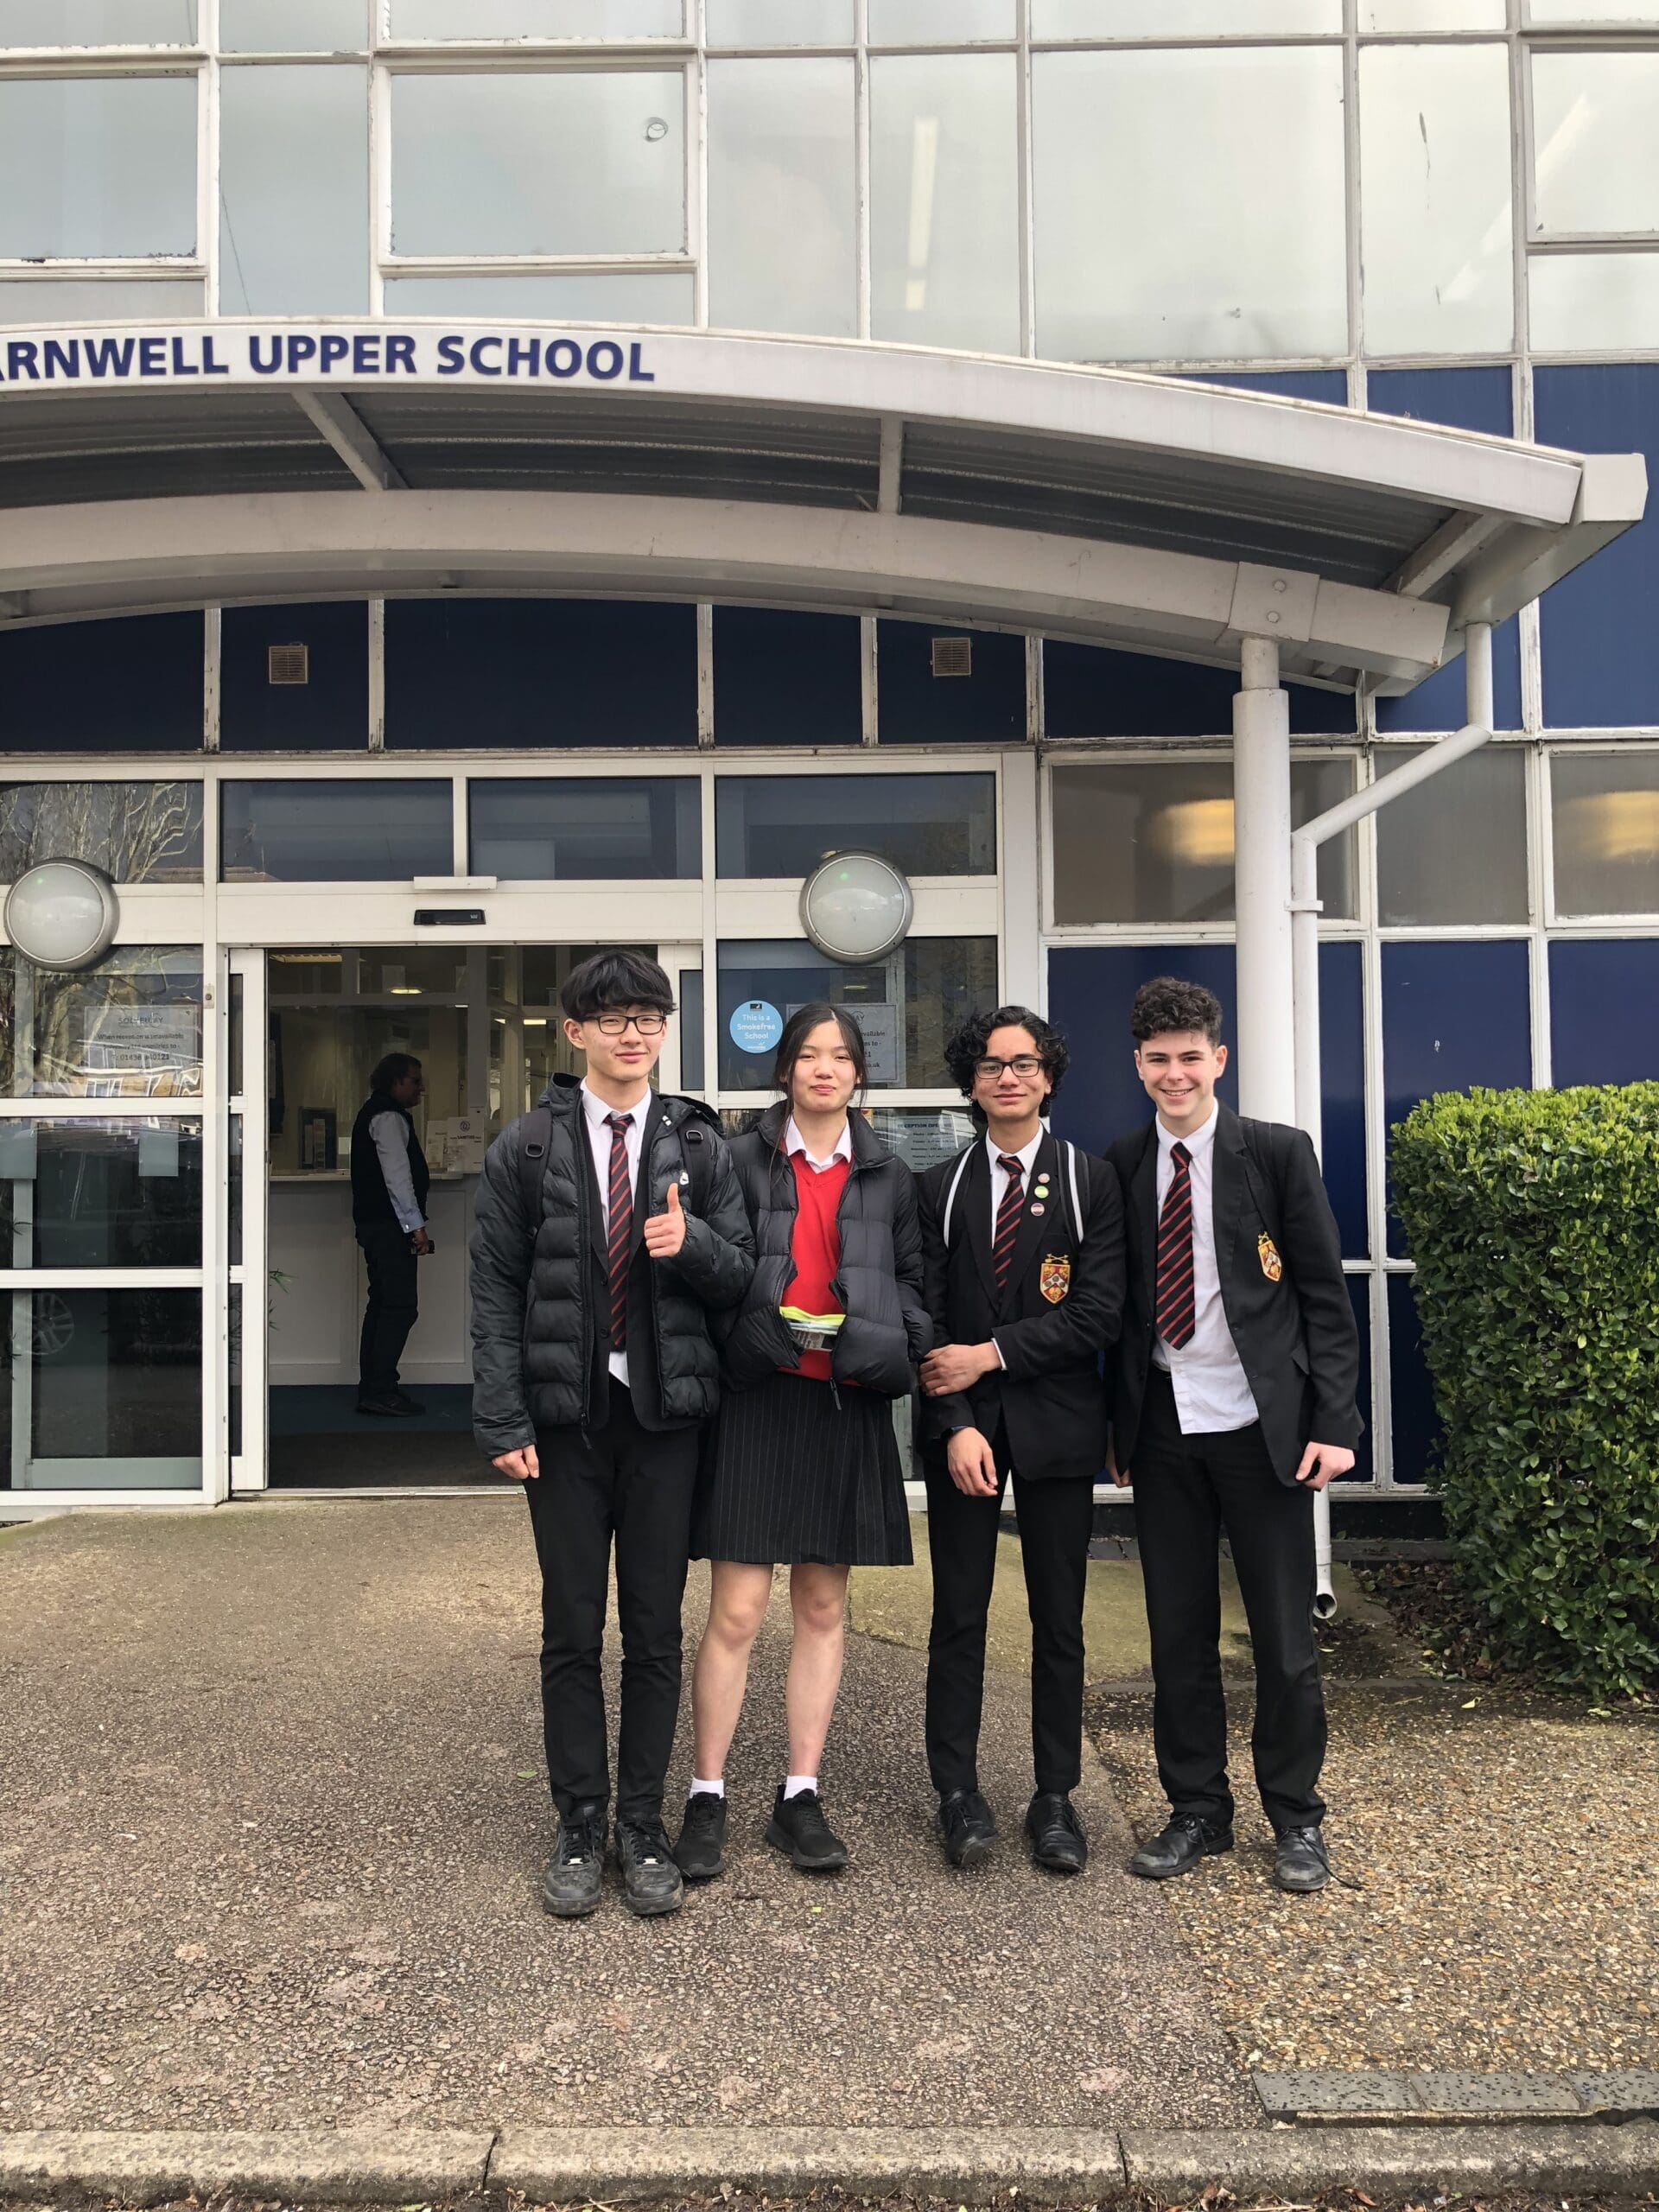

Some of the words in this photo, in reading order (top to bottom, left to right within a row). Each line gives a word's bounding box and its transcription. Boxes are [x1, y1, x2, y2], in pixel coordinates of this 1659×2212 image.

[0, 335, 229, 381] RNWELL
[249, 334, 417, 374] UPPER
[437, 335, 655, 382] SCHOOL
